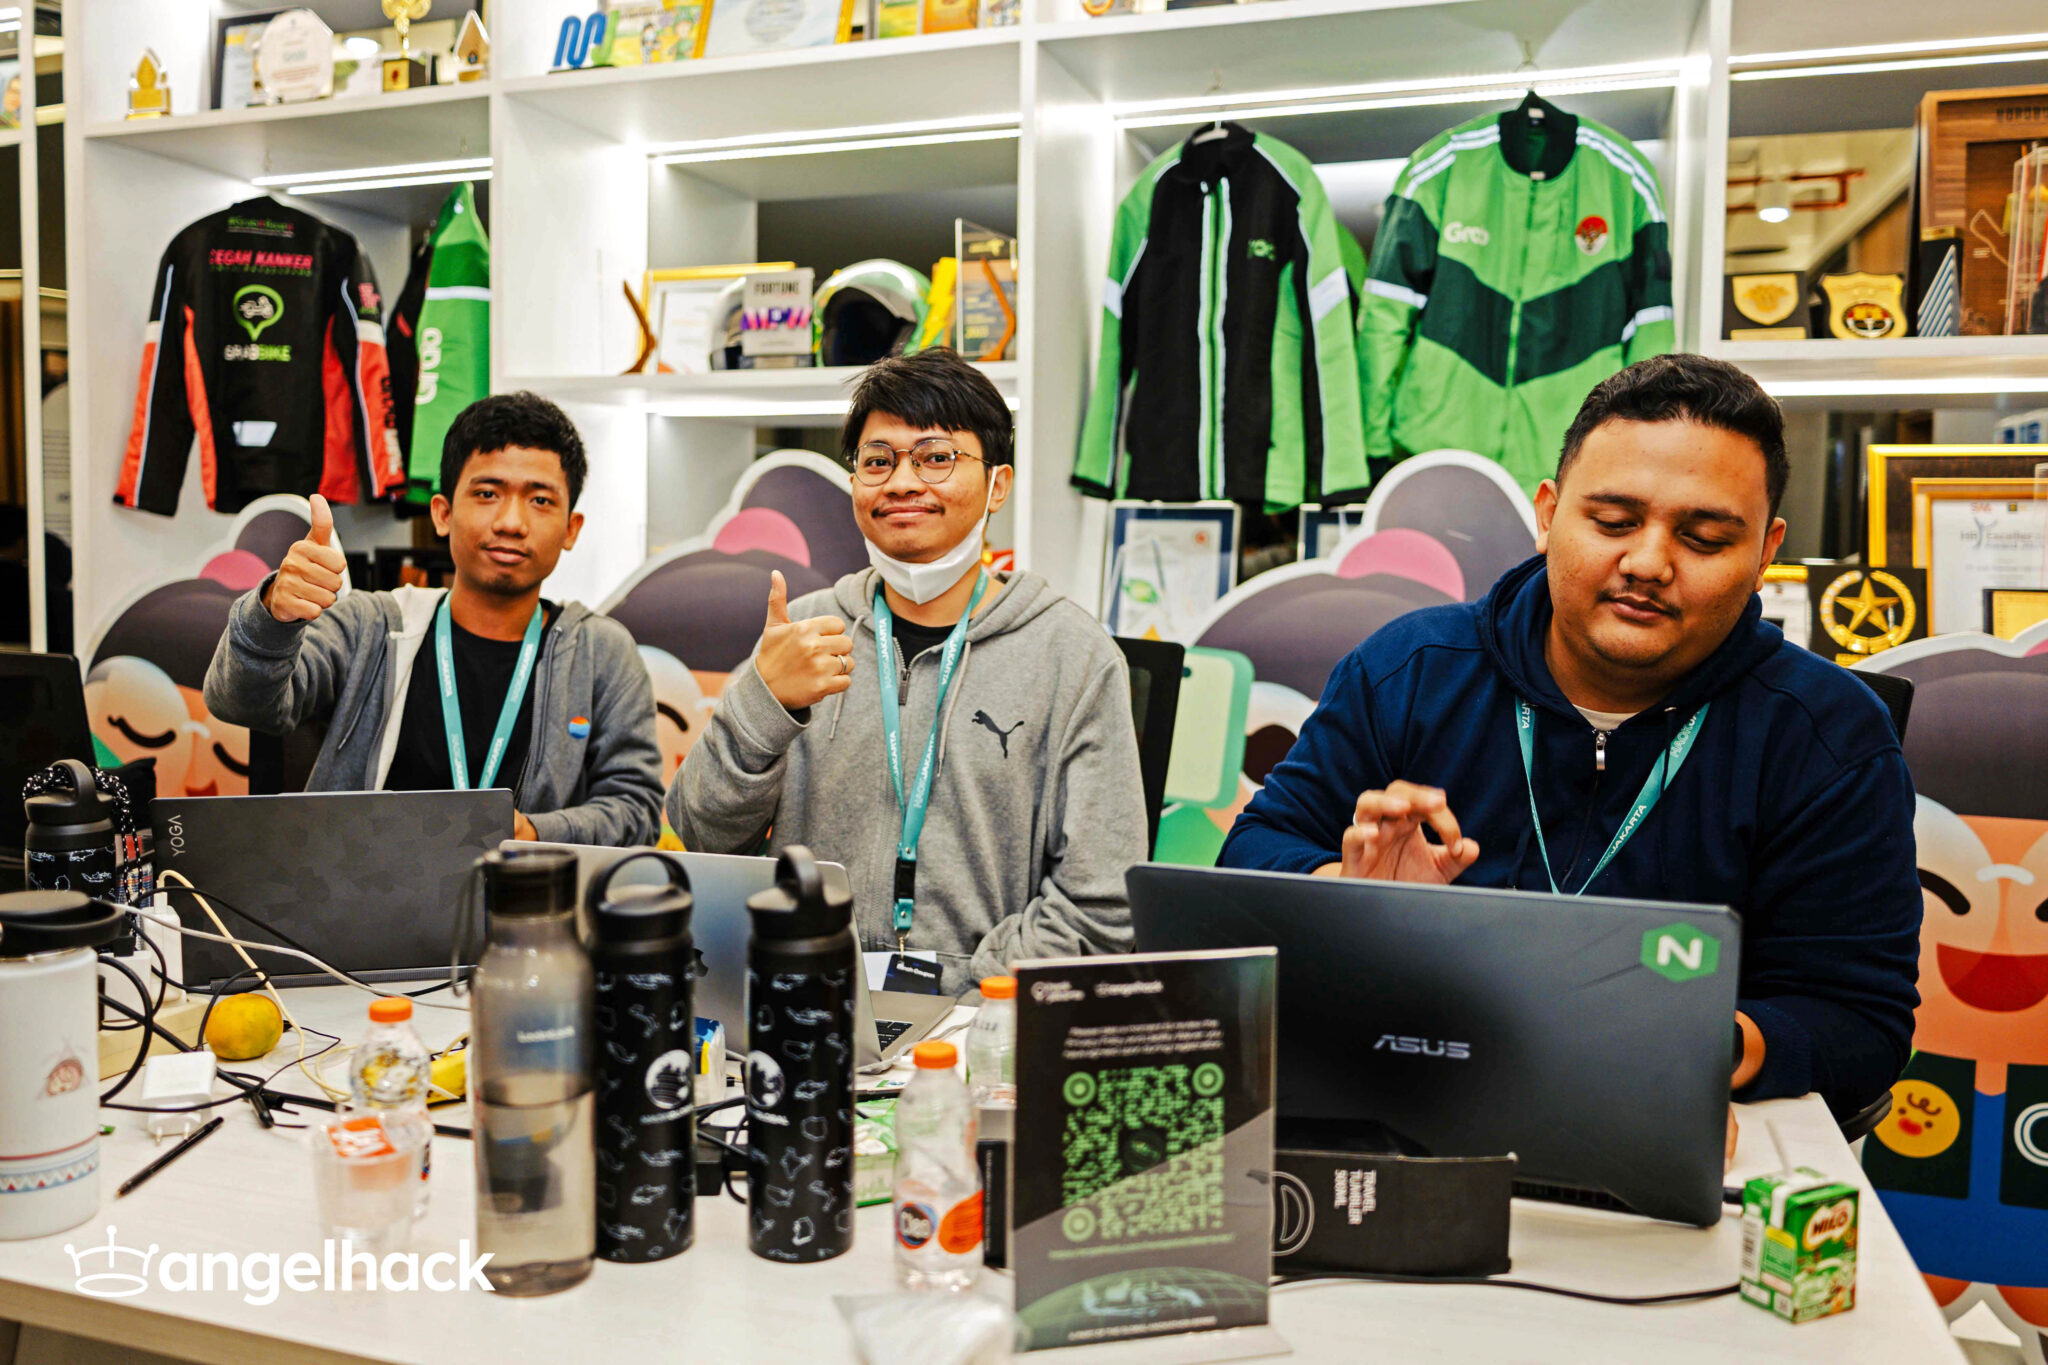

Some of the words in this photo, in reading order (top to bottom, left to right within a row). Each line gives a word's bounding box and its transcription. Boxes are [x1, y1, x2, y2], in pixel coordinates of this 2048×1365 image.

[167, 814, 186, 858] YOGA
[1656, 934, 1703, 971] N
[1373, 1034, 1470, 1059] ASUS
[1811, 1210, 1849, 1236] MILO
